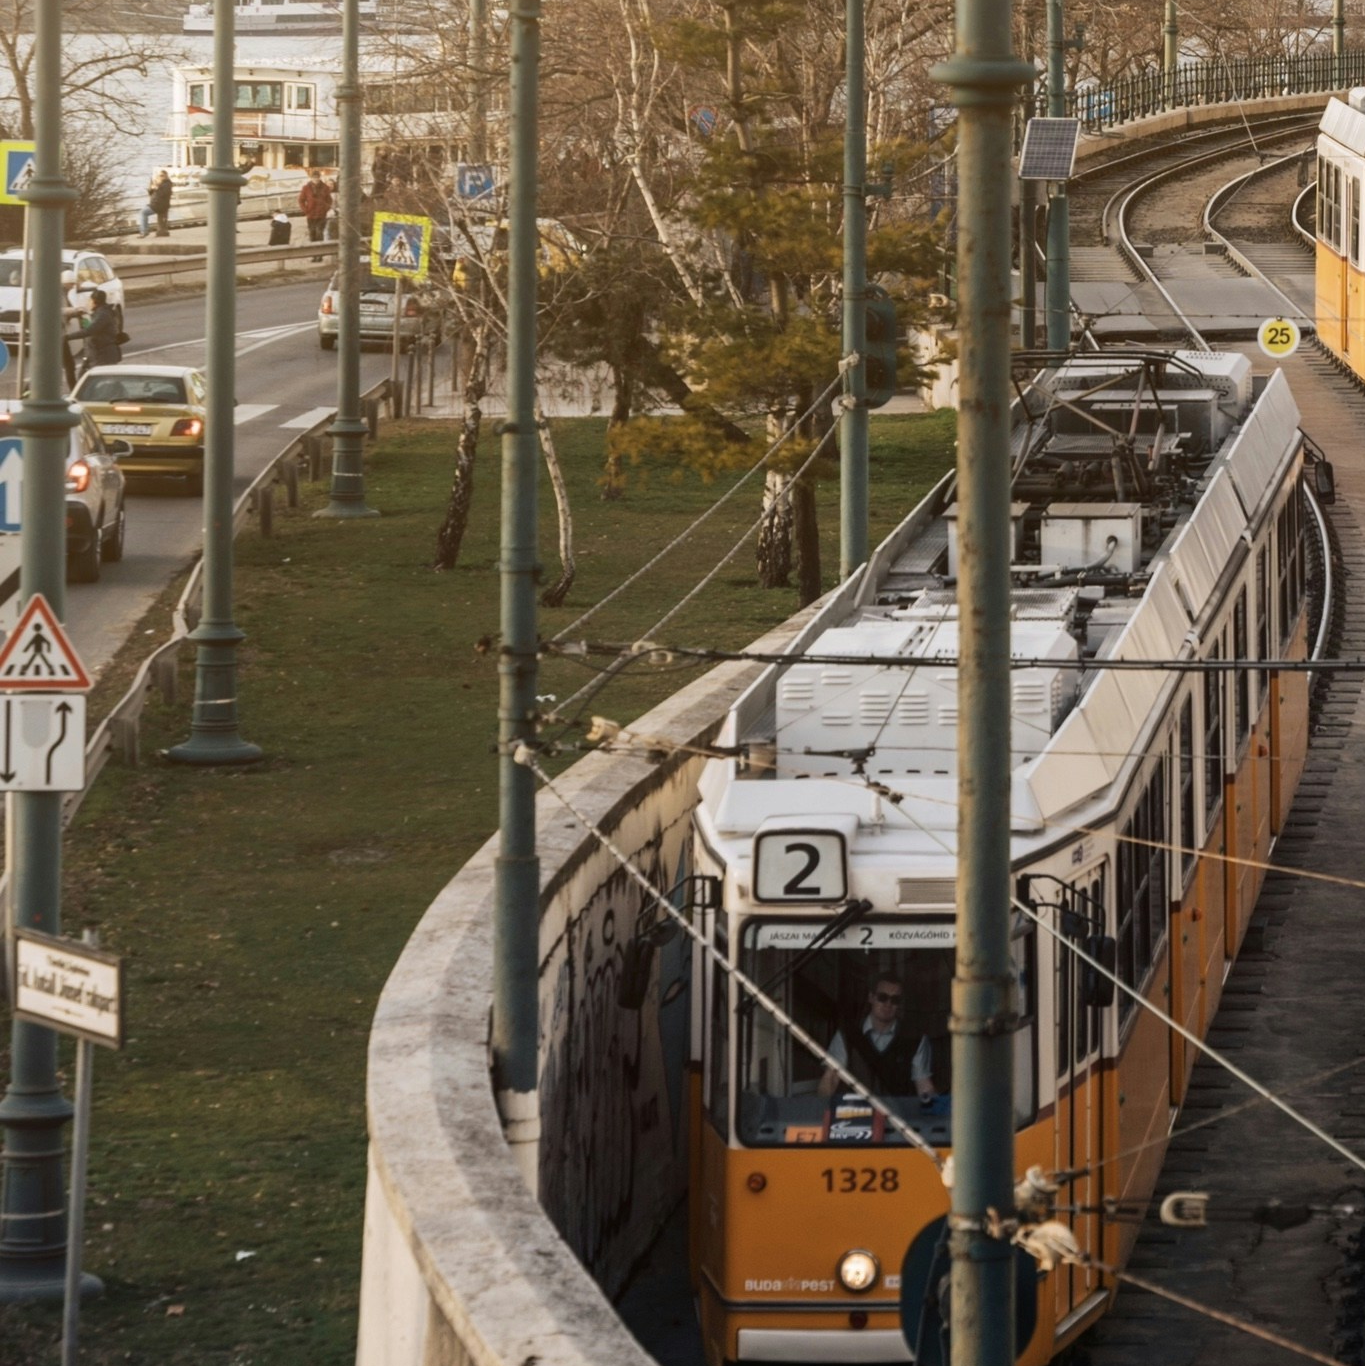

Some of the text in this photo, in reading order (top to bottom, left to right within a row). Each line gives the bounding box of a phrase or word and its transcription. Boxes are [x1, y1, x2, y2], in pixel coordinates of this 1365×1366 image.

[1268, 328, 1290, 344] 25
[783, 842, 821, 895] 2
[860, 927, 873, 945] 2
[822, 1168, 899, 1192] 1328
